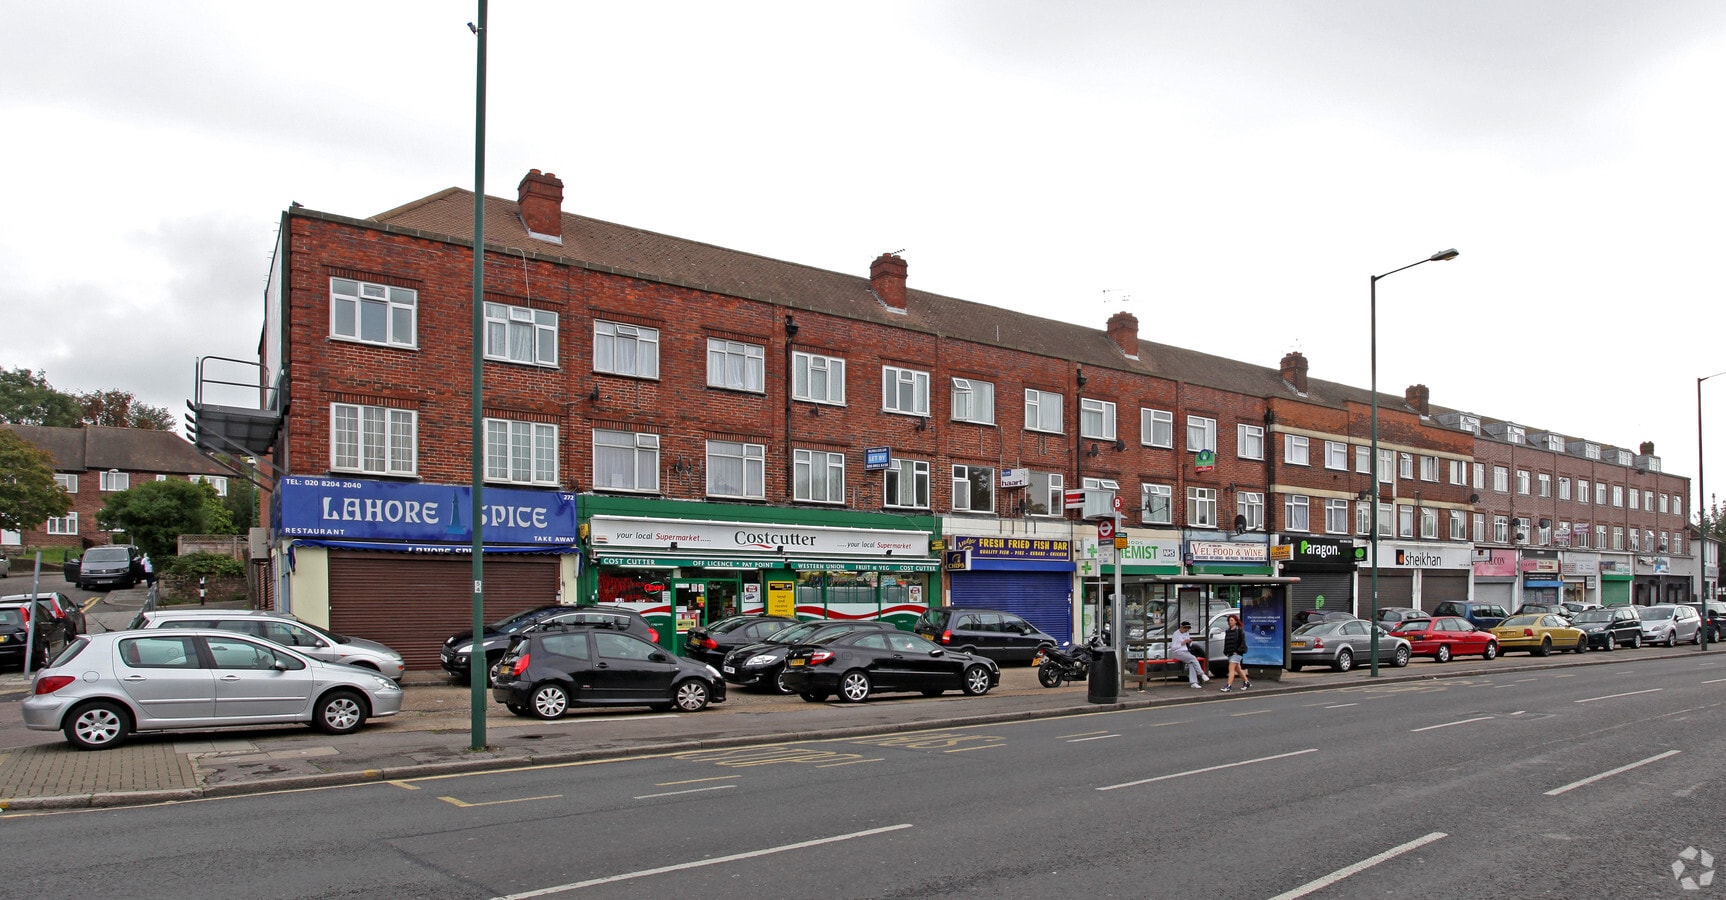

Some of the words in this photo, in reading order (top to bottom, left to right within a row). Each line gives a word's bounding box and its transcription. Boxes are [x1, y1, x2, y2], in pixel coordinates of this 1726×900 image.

[322, 496, 440, 524] LAHORE
[636, 532, 652, 540] local
[734, 530, 816, 546] Costcutter
[862, 540, 876, 548] local
[876, 541, 912, 550] Supermarket
[979, 538, 1004, 548] FRESH
[1008, 540, 1030, 548] FRIED
[1034, 540, 1050, 550] FISH
[1053, 541, 1068, 550] BAR
[1192, 542, 1210, 556] VEL
[1213, 547, 1234, 556] FOOD
[1244, 548, 1263, 556] WINE
[1121, 546, 1158, 560] EMIST
[1162, 549, 1176, 558] NHS
[1406, 552, 1442, 566] sheikhan
